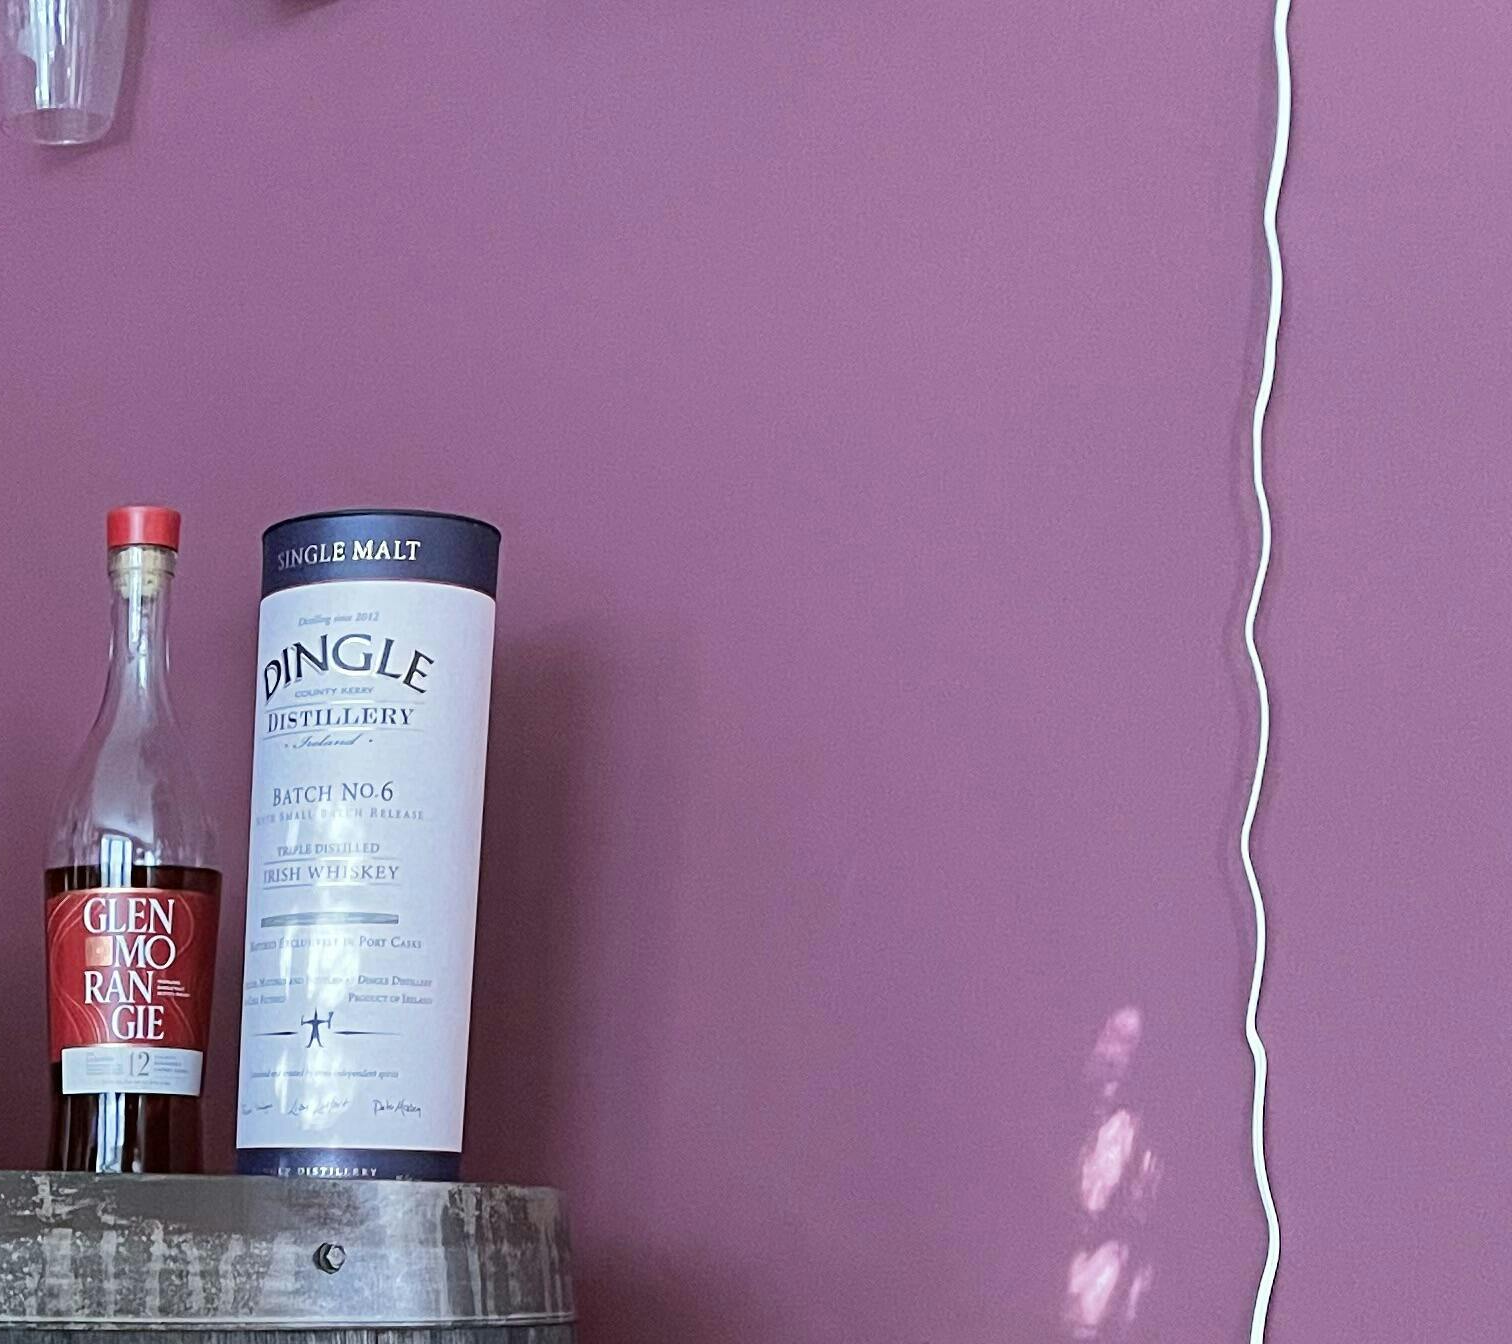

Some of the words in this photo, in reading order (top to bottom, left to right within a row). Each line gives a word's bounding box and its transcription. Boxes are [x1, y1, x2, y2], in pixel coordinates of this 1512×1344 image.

[277, 541, 346, 571] SINGLE
[351, 539, 422, 561] MALT
[264, 633, 435, 702] DINGLE
[268, 707, 416, 734] DISTILLERY
[273, 784, 332, 807] BATCH
[264, 866, 301, 884] IRISH
[308, 864, 400, 881] WHISKEY
[82, 897, 175, 934] GLEN
[113, 935, 177, 970] MO
[84, 970, 153, 1004] RAN
[111, 1005, 165, 1040] GIE
